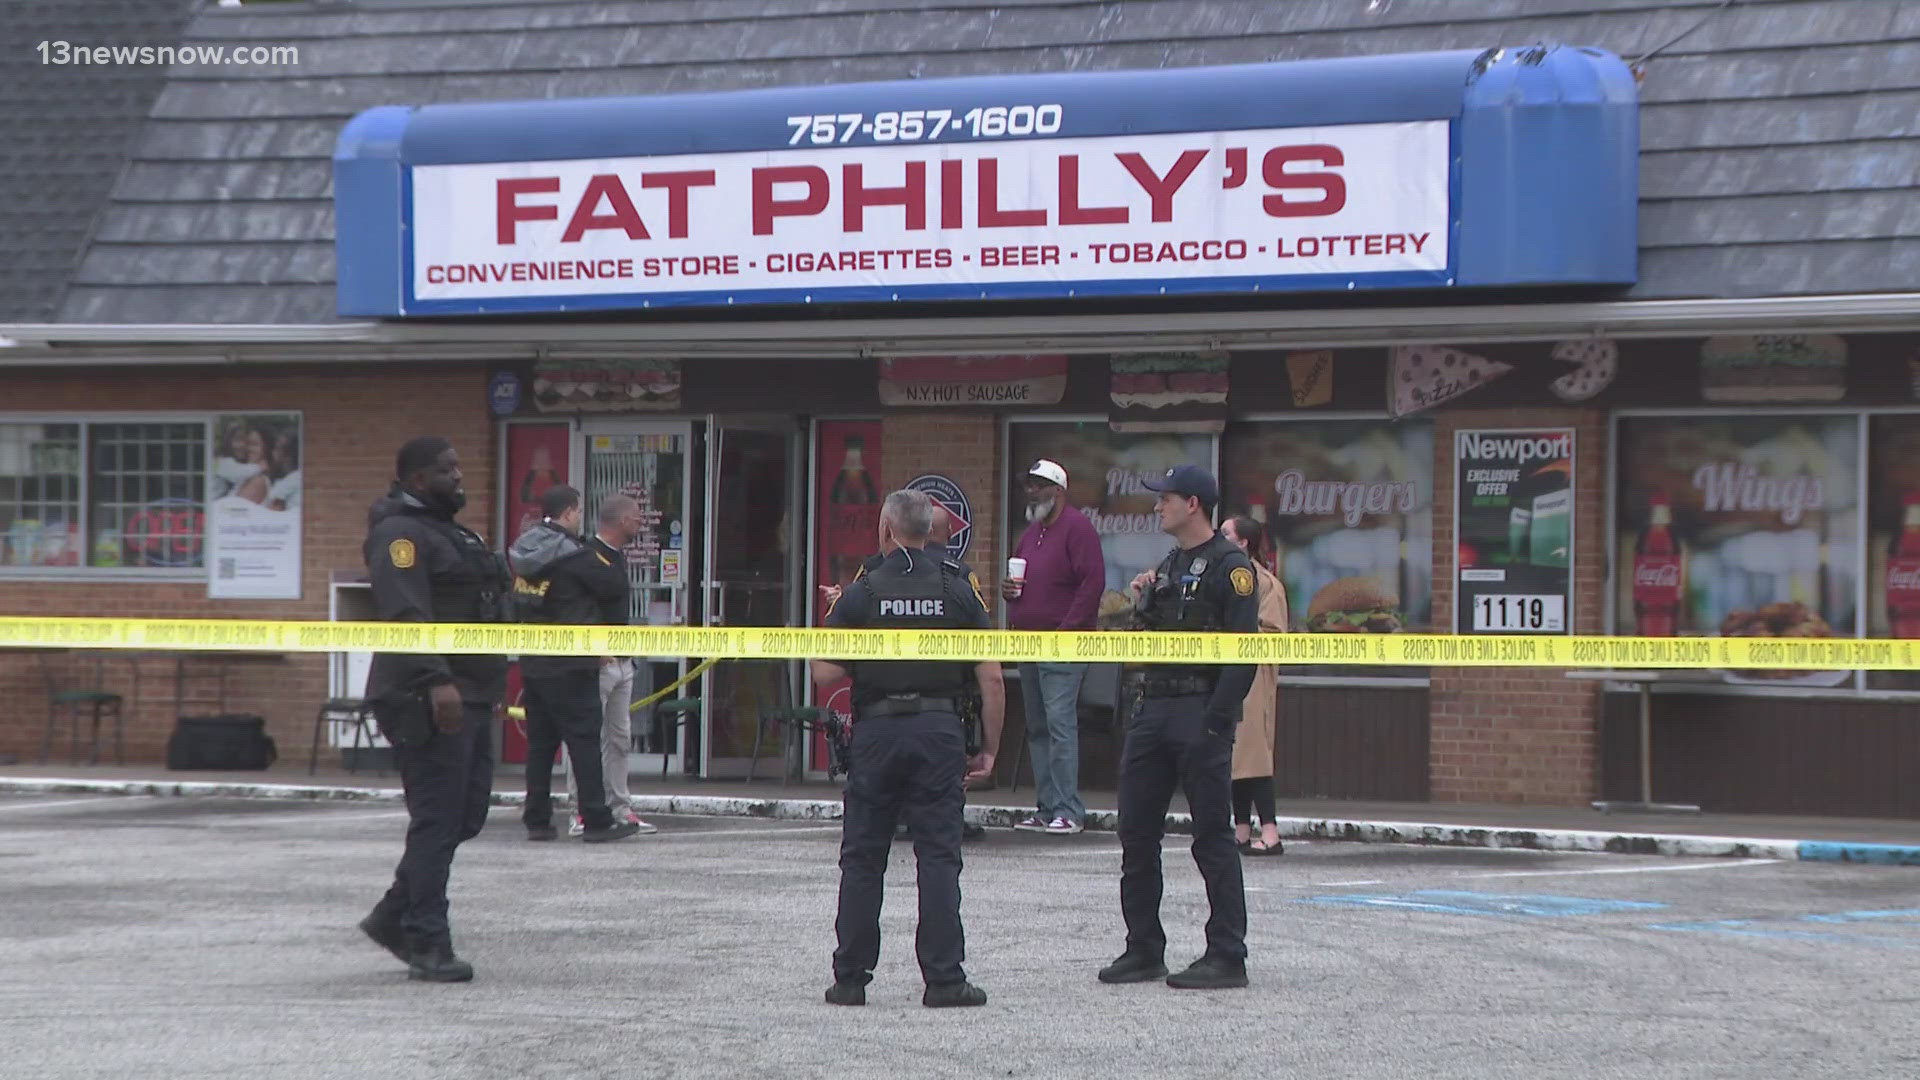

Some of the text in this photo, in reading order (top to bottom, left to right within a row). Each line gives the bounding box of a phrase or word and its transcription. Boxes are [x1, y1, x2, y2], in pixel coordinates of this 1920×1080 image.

[786, 104, 1063, 145] 757-857-1600
[496, 143, 1347, 245] FAT PHILLY'S
[427, 258, 634, 284] CONVENIENCE
[643, 255, 740, 277] STORE
[766, 248, 953, 273] CIGARETTES
[980, 245, 1060, 267] BEER
[1088, 239, 1248, 264] TOBACCO
[1277, 233, 1431, 259] LOTTERY
[967, 384, 1030, 401] SAUSAGE
[1420, 378, 1463, 405] PIZZA
[1461, 431, 1570, 464] Newport
[1466, 468, 1521, 482] EXCLUSIVE
[1476, 482, 1509, 496] OFFER
[1275, 469, 1417, 528] Burgers
[1692, 462, 1825, 525] Wings
[880, 599, 944, 616] POLICE
